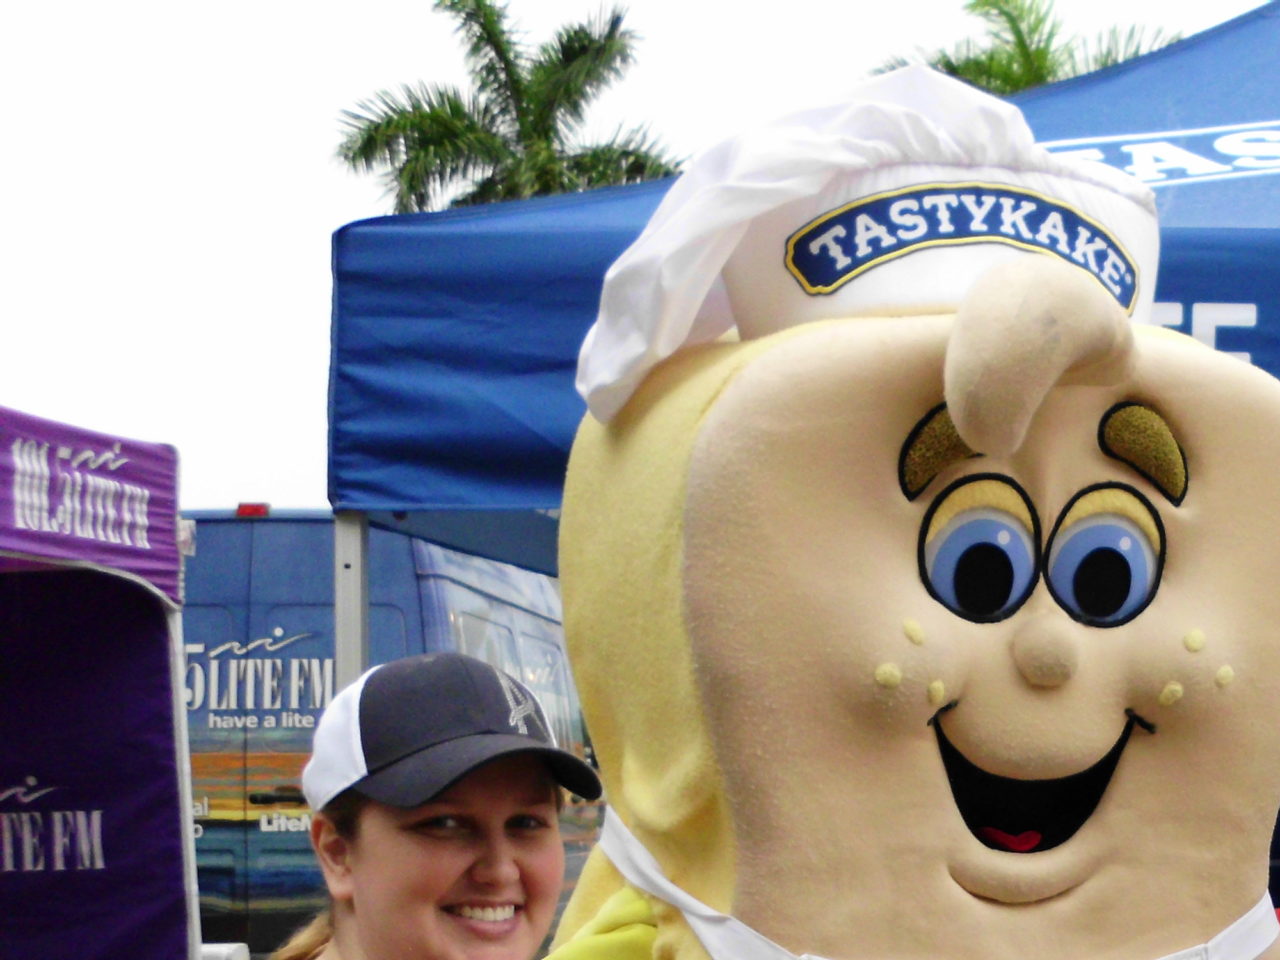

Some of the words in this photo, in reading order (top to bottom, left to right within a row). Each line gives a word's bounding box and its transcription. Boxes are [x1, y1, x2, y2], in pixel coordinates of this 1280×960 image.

[807, 195, 1127, 295] TASTYKAKE
[290, 658, 335, 709] FM
[208, 713, 258, 729] have
[263, 715, 276, 728] a
[281, 712, 315, 728] lite
[51, 809, 106, 870] FM
